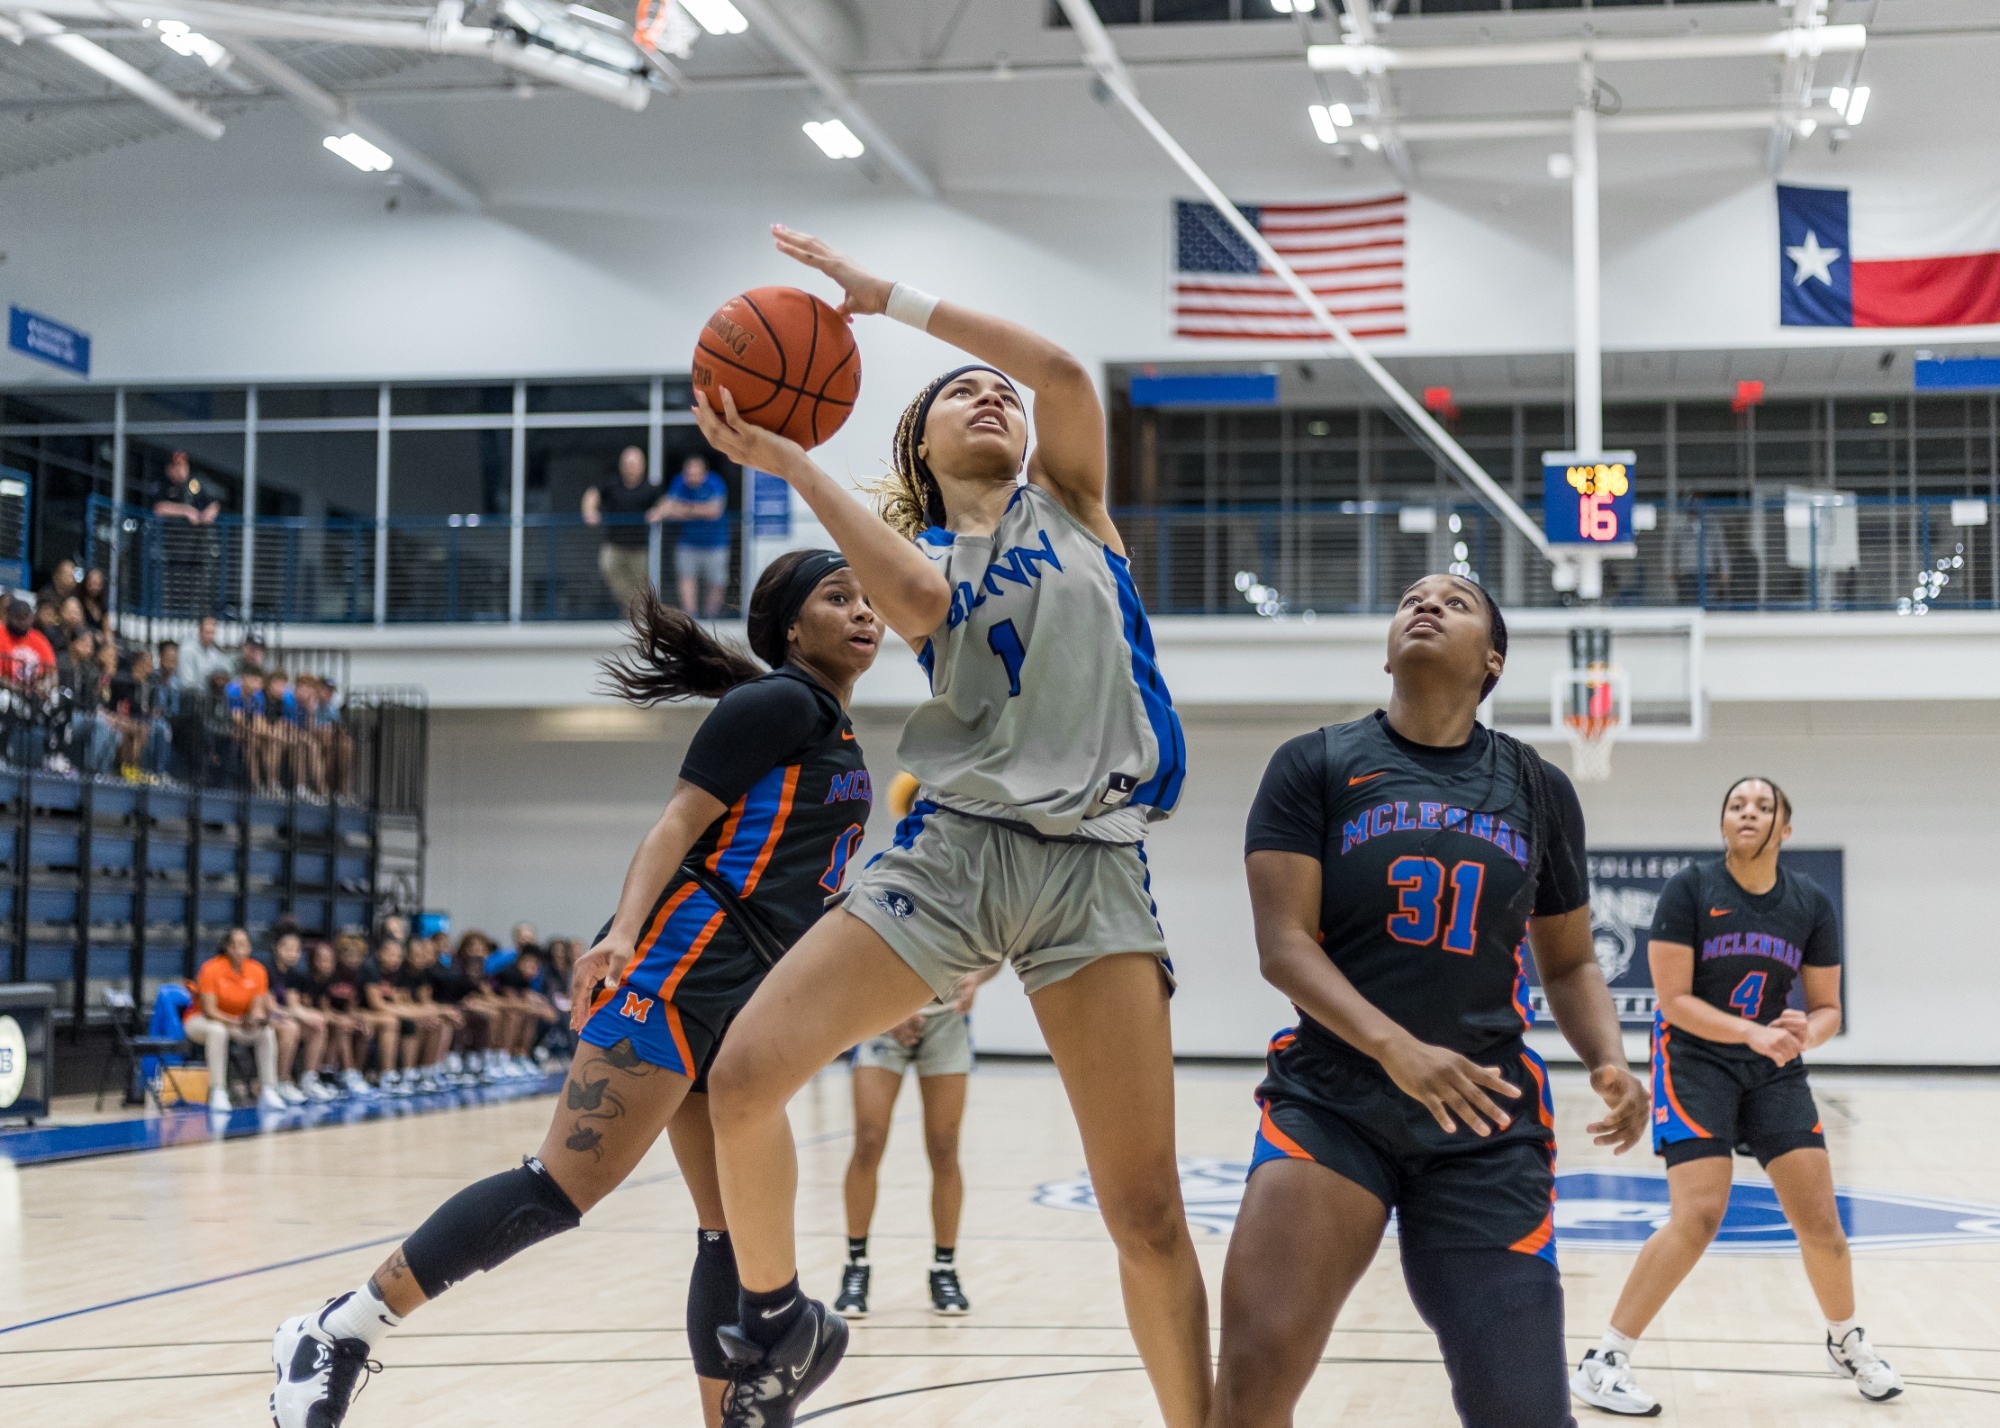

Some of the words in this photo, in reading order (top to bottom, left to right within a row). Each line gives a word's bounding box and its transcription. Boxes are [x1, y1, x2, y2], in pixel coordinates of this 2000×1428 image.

[1579, 493, 1618, 541] 16
[946, 529, 1064, 629] BLNN
[987, 618, 1026, 697] 1
[824, 769, 873, 805] MCL
[1120, 777, 1128, 790] L
[1387, 855, 1485, 955] 31
[620, 991, 654, 1023] M
[1728, 970, 1768, 1019] 4
